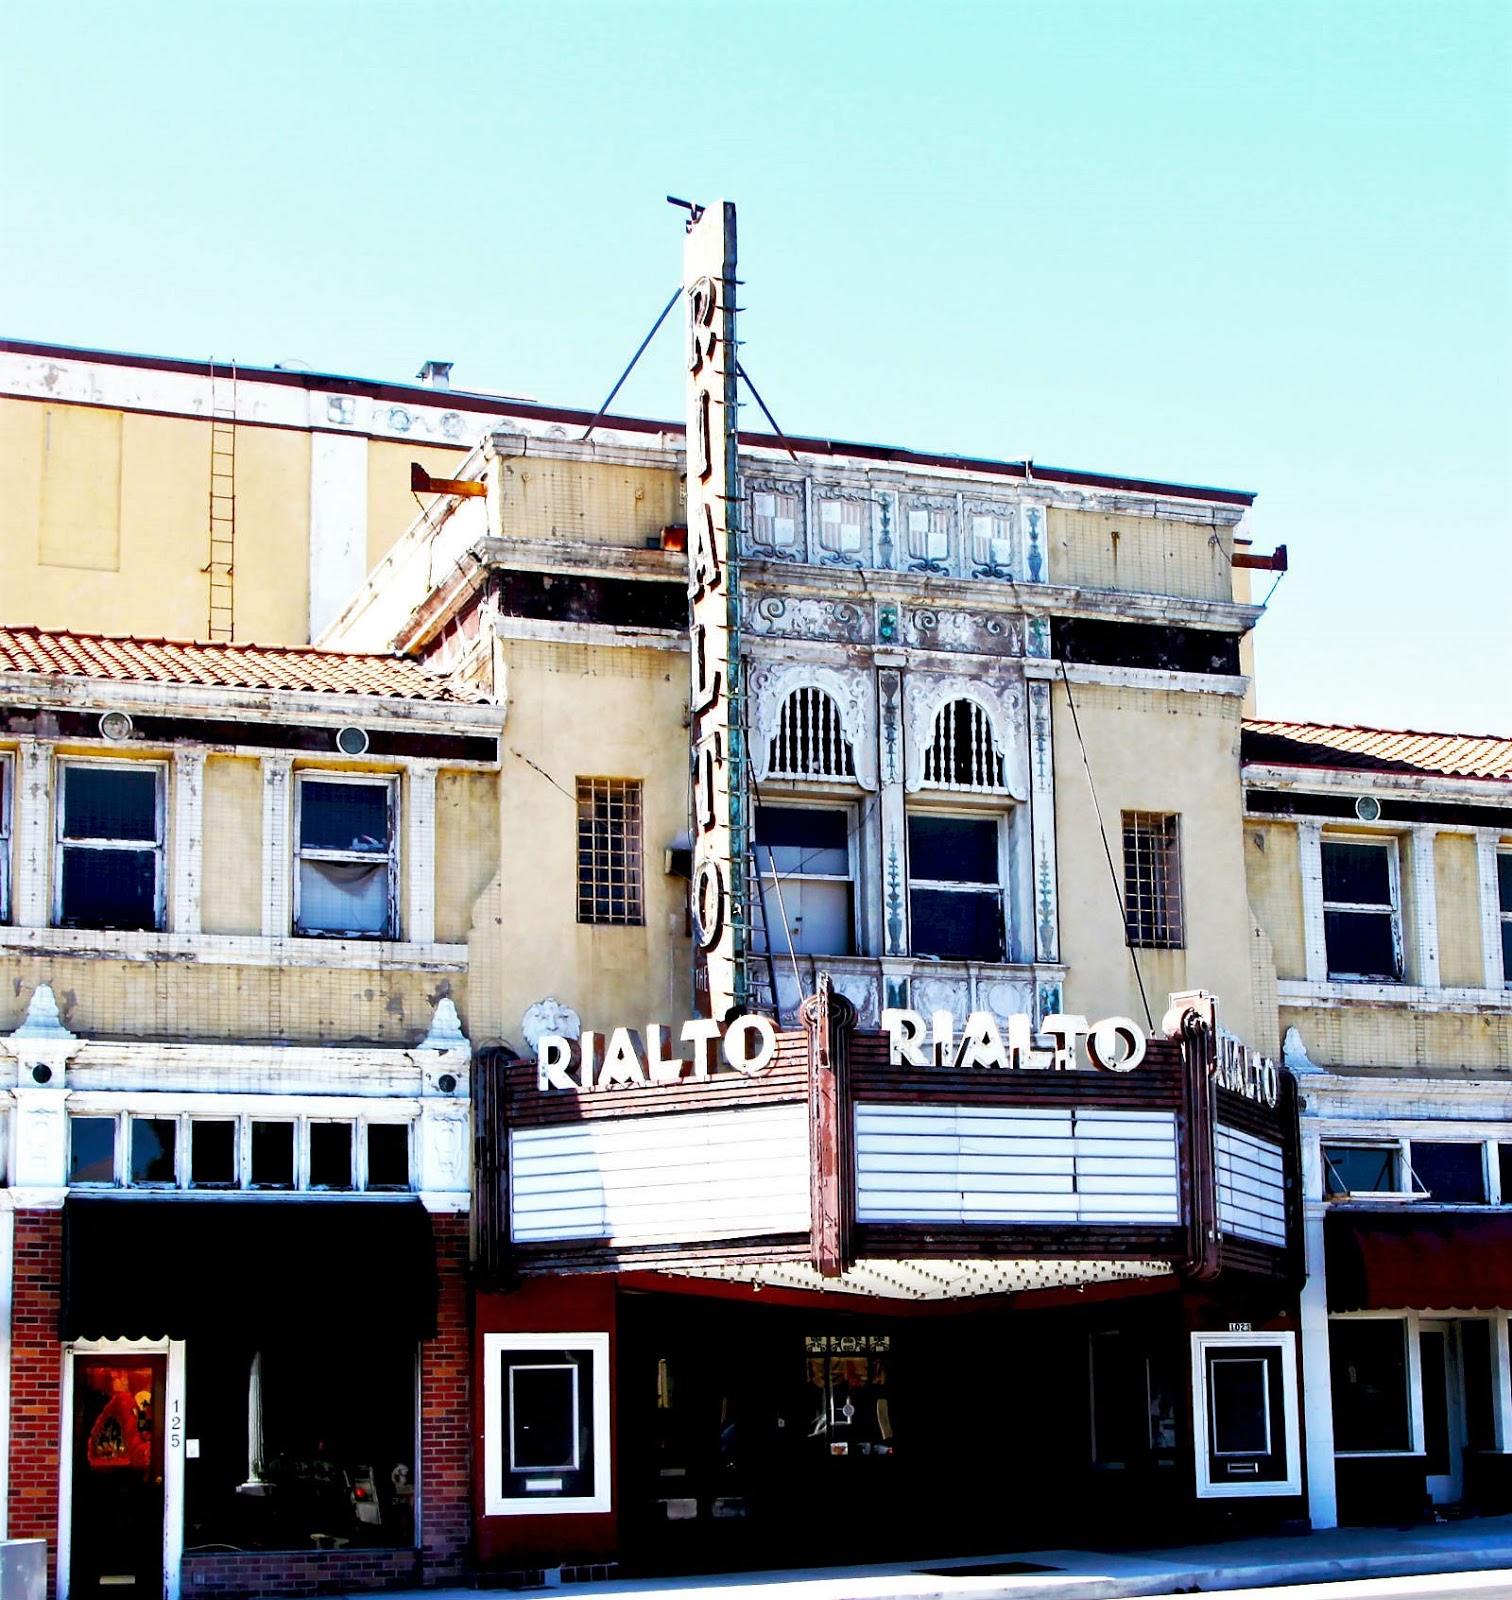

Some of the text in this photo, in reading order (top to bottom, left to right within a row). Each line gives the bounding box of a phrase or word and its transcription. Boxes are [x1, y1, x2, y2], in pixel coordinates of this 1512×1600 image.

[687, 275, 724, 952] RIALTO
[537, 1014, 778, 1091] RIALTO
[881, 1008, 1147, 1073] RIALTO
[171, 1400, 180, 1447] 125
